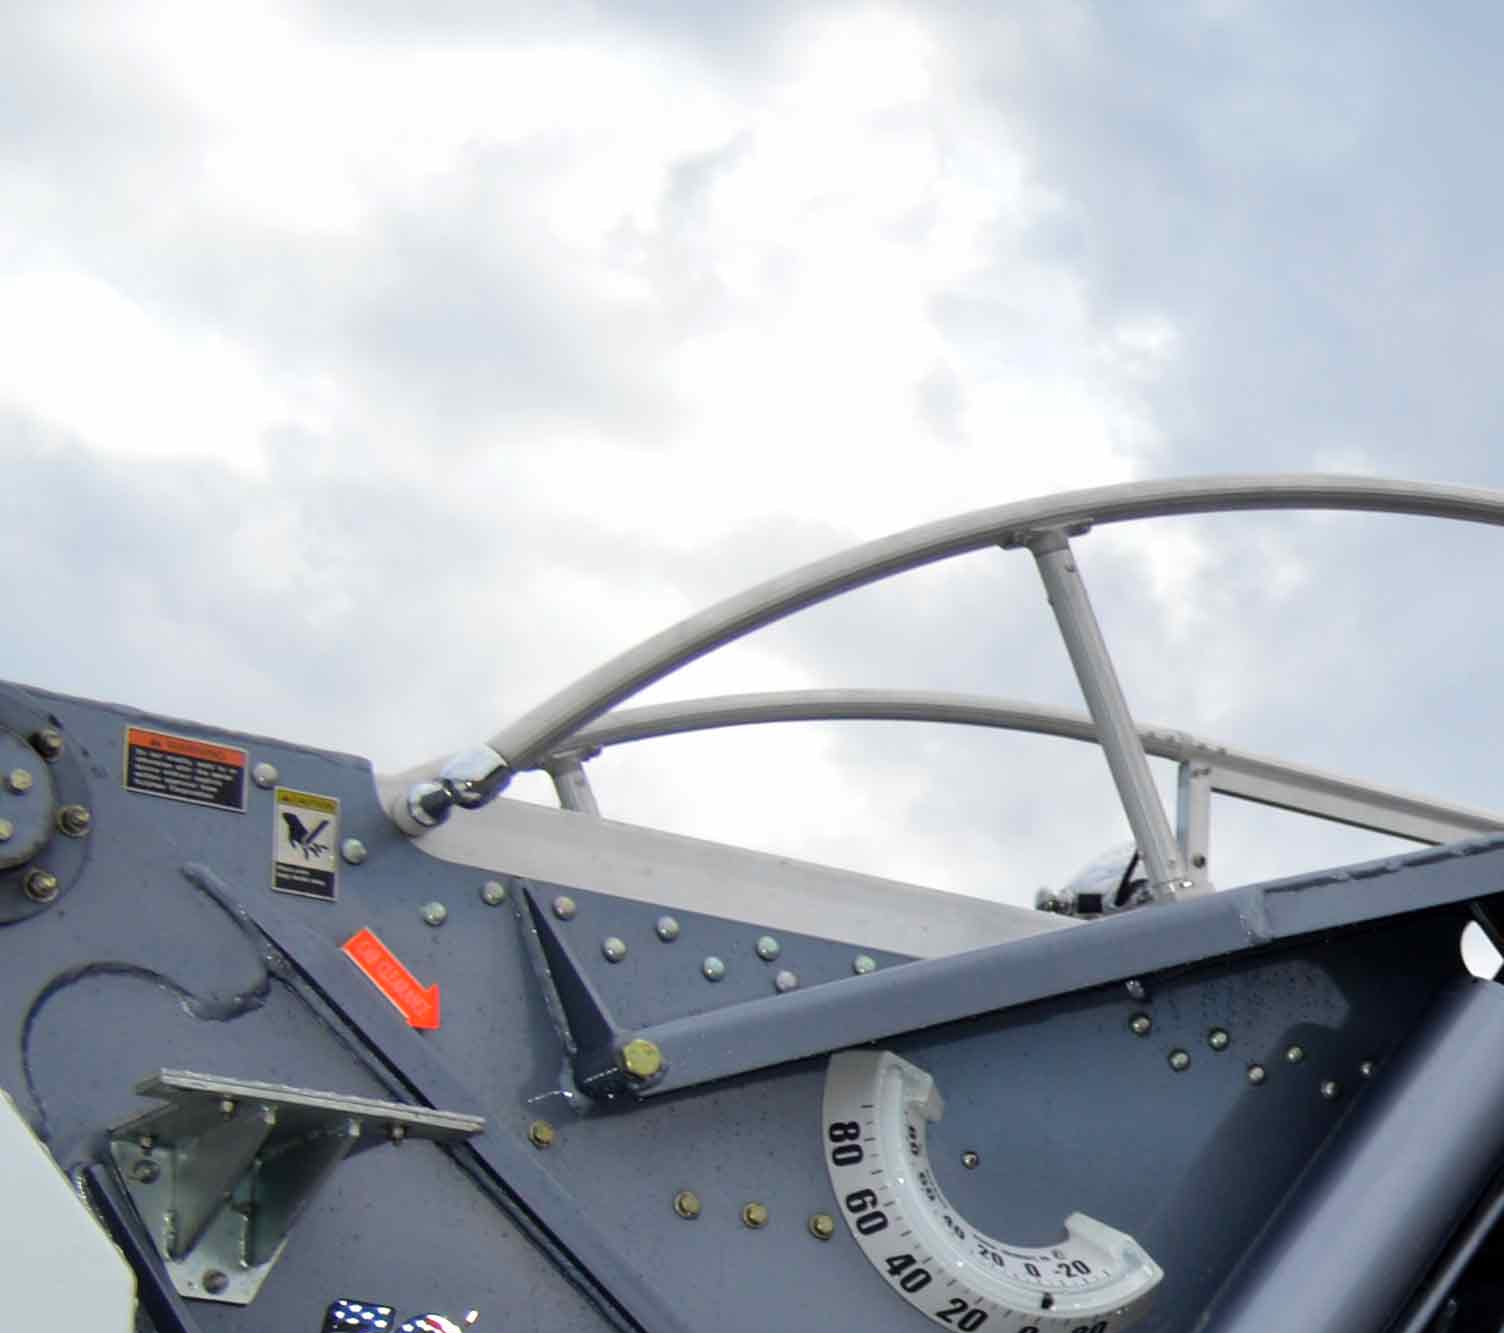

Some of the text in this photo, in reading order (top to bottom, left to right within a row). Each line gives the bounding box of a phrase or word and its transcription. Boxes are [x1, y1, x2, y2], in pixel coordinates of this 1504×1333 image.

[829, 1121, 863, 1167] 80
[845, 1188, 889, 1236] 60
[885, 1253, 932, 1294] 40
[1024, 1263, 1042, 1278] 0
[936, 1297, 989, 1333] 20
